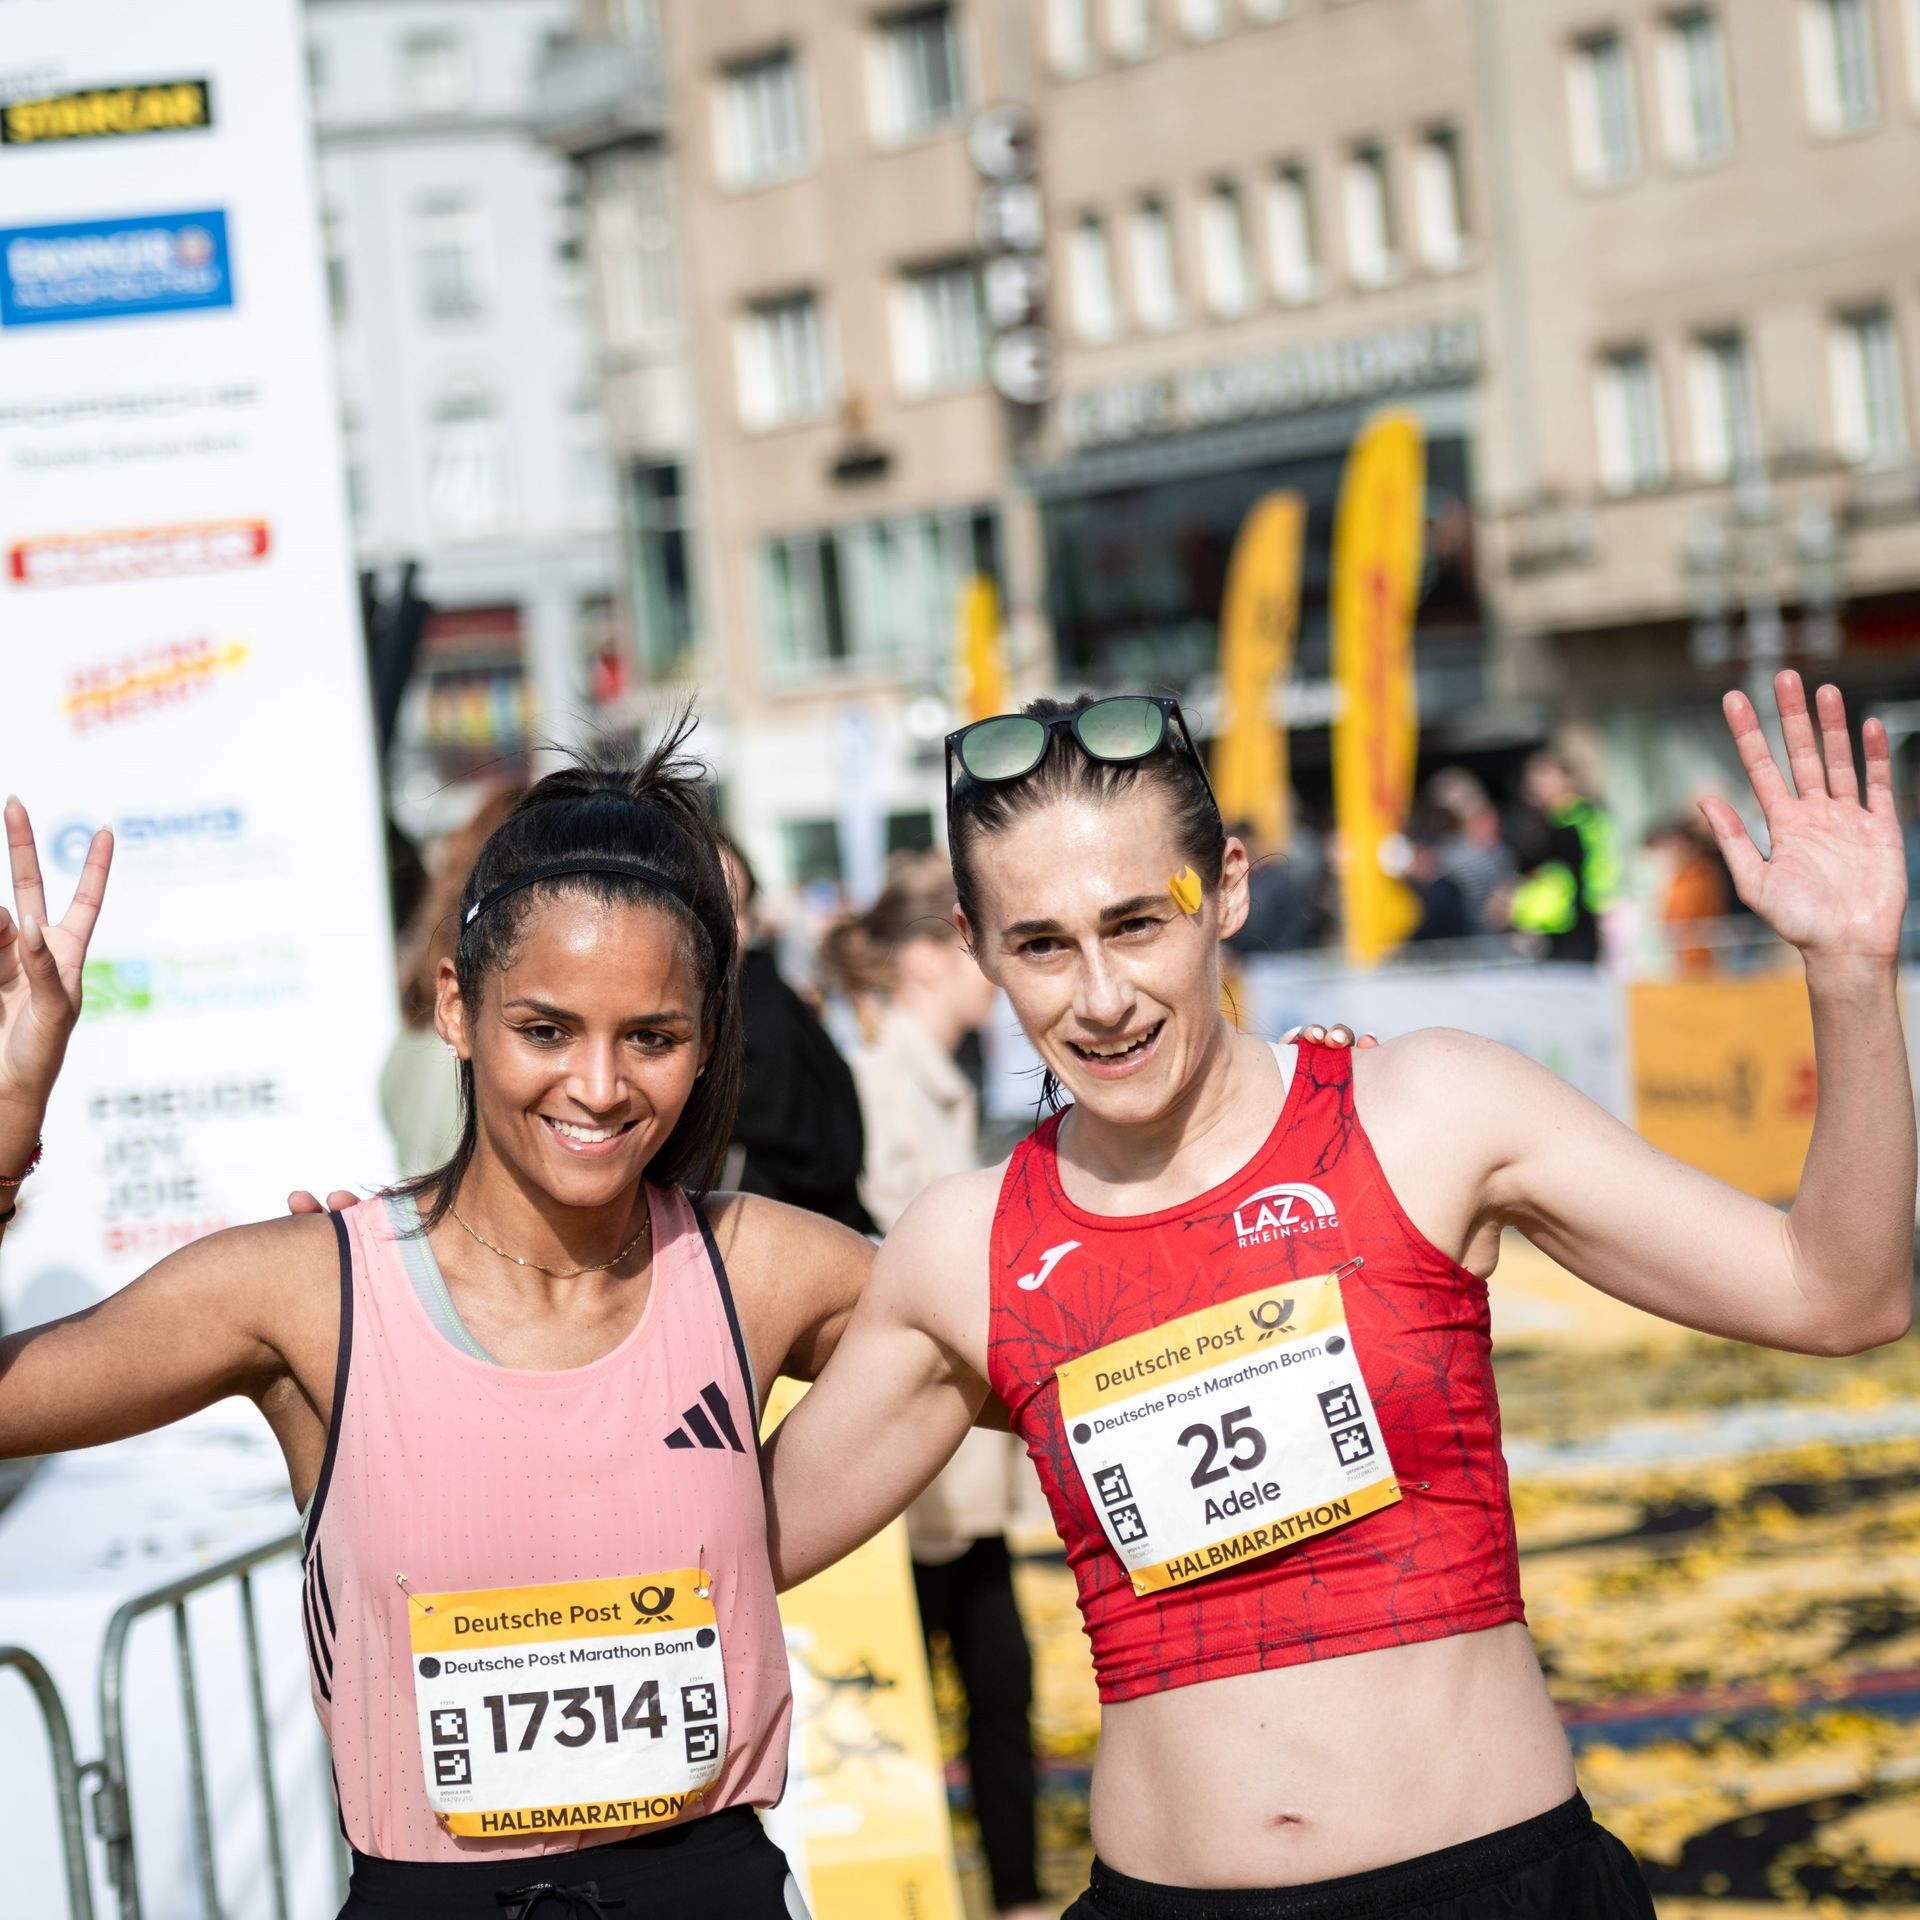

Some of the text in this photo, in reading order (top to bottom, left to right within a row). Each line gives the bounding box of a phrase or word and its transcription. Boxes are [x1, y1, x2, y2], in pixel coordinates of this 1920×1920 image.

[1232, 1196, 1300, 1237] LAZ
[1238, 1216, 1339, 1248] RHEIN-SIEG
[1095, 1324, 1245, 1392] Deutsche Post
[1094, 1346, 1322, 1434] Deutsche Post Marathon Bonn
[1176, 1405, 1267, 1489] 25
[1204, 1481, 1281, 1525] Adele
[1166, 1498, 1352, 1581] HALBMARATHON
[454, 1602, 622, 1634] Deutsche Post
[444, 1639, 693, 1675] Deutsche Post Marathon Bonn
[483, 1680, 668, 1753] 17314
[481, 1796, 687, 1832] HALBMARATHON
